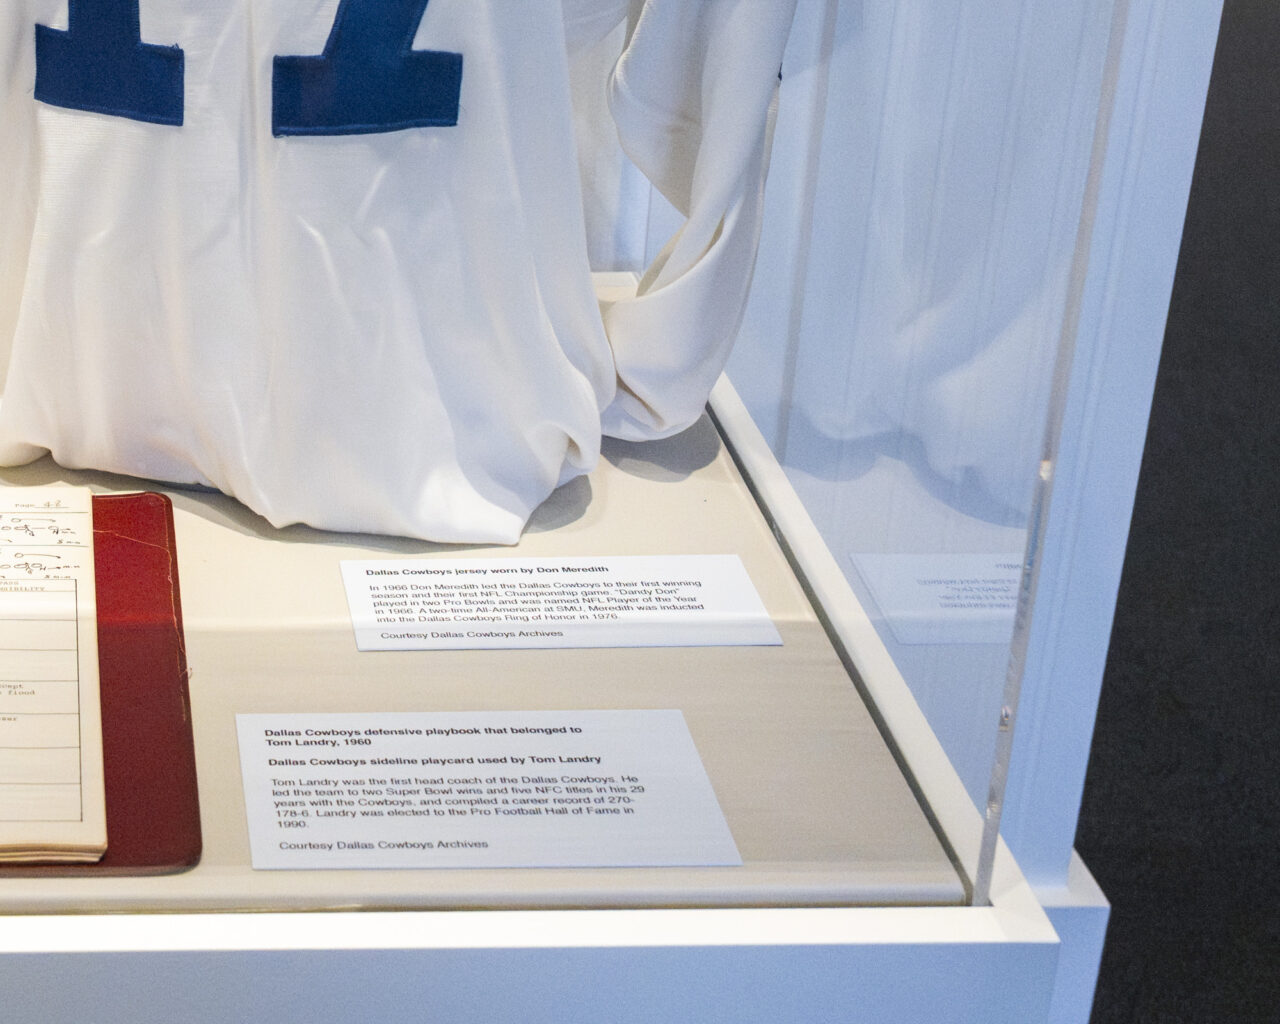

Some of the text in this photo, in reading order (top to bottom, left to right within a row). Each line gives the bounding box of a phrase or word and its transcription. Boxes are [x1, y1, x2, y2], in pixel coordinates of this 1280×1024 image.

[305, 729, 360, 737] Cowboys
[365, 728, 422, 736] defensive
[511, 727, 567, 735] belonged
[296, 739, 340, 747] Landry,
[310, 758, 366, 766] Cowboys
[422, 757, 474, 765] playcard
[511, 756, 525, 765] by
[559, 756, 601, 764] Landry
[300, 779, 338, 787] Landry
[386, 788, 420, 796] Super
[274, 800, 305, 808] years
[445, 797, 497, 806] compiled
[316, 810, 357, 818] Landry
[280, 842, 332, 850] Courtesy
[337, 841, 374, 849] Dallas
[378, 841, 433, 849] Cowboys
